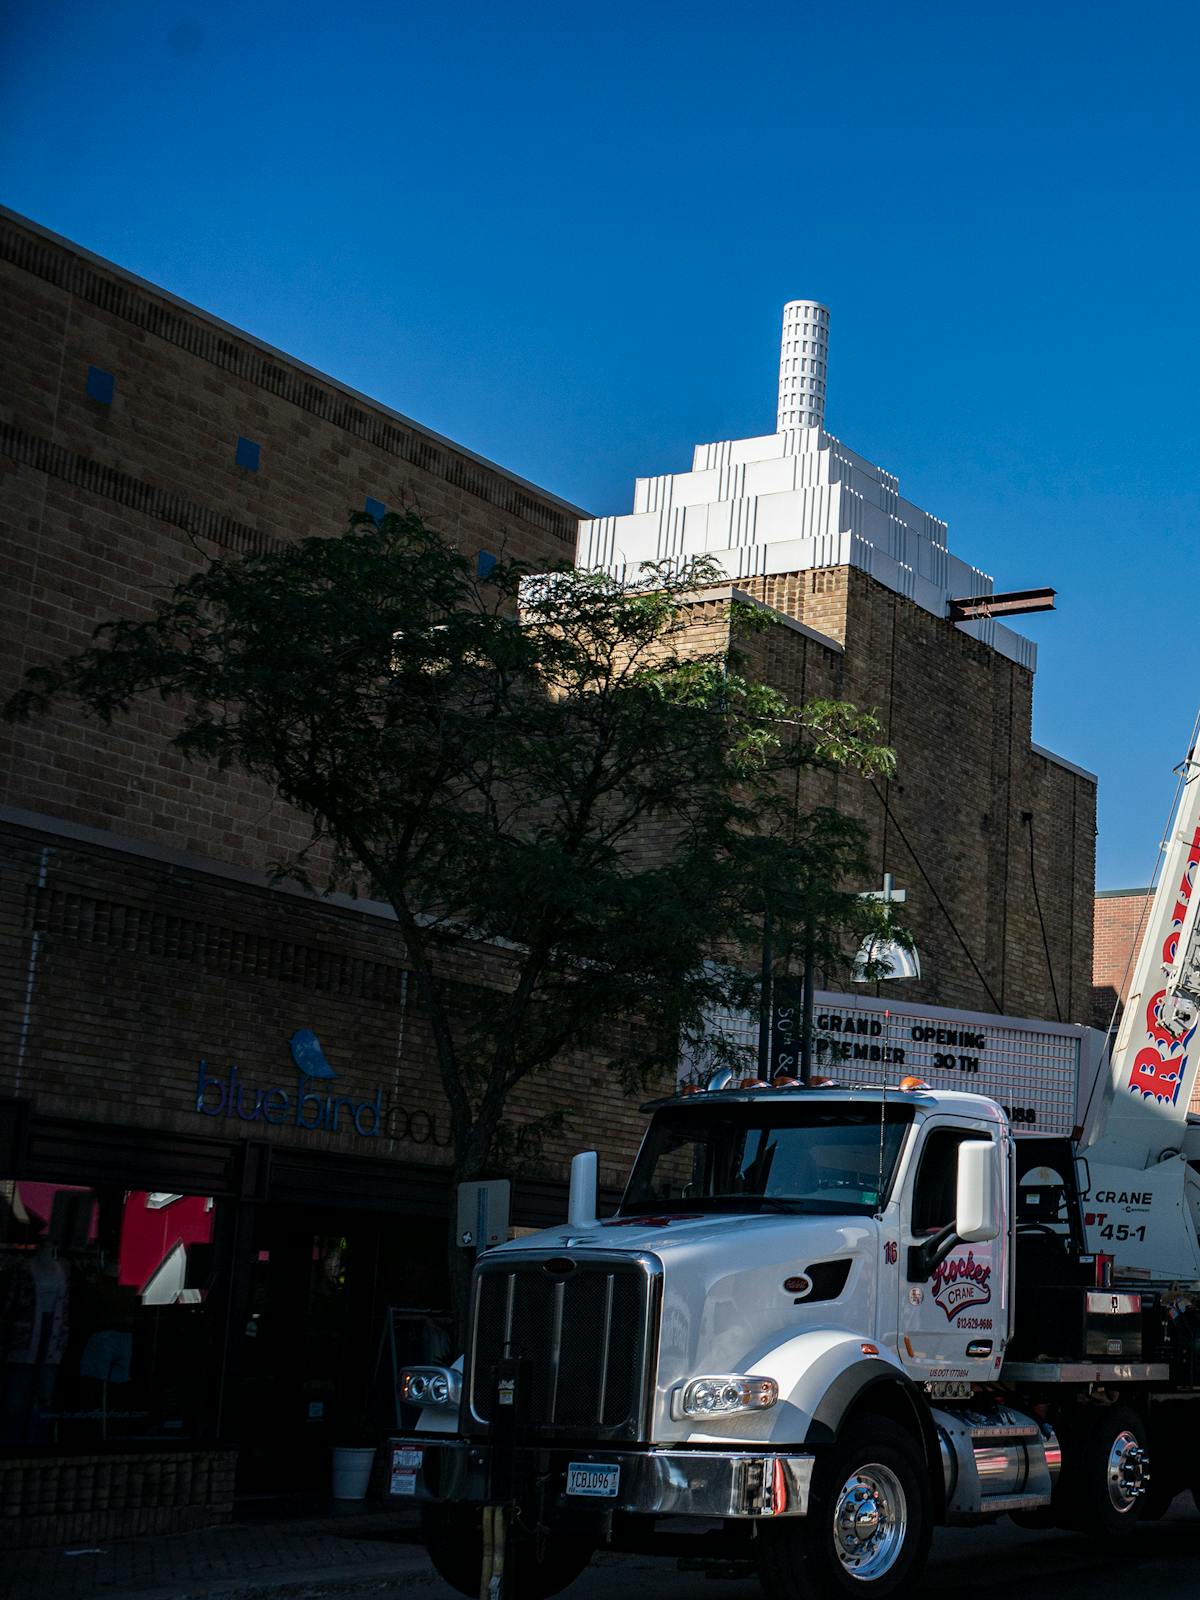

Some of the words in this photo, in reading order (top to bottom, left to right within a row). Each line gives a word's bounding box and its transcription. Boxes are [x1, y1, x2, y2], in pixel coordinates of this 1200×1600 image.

[817, 1014, 882, 1036] GRAND
[911, 1025, 985, 1050] OPENING
[1095, 1191, 1153, 1205] CRANE
[1100, 1224, 1146, 1242] 45-1
[883, 1241, 898, 1266] 16
[931, 1250, 992, 1297] Rocket
[948, 1287, 975, 1304] CRANE
